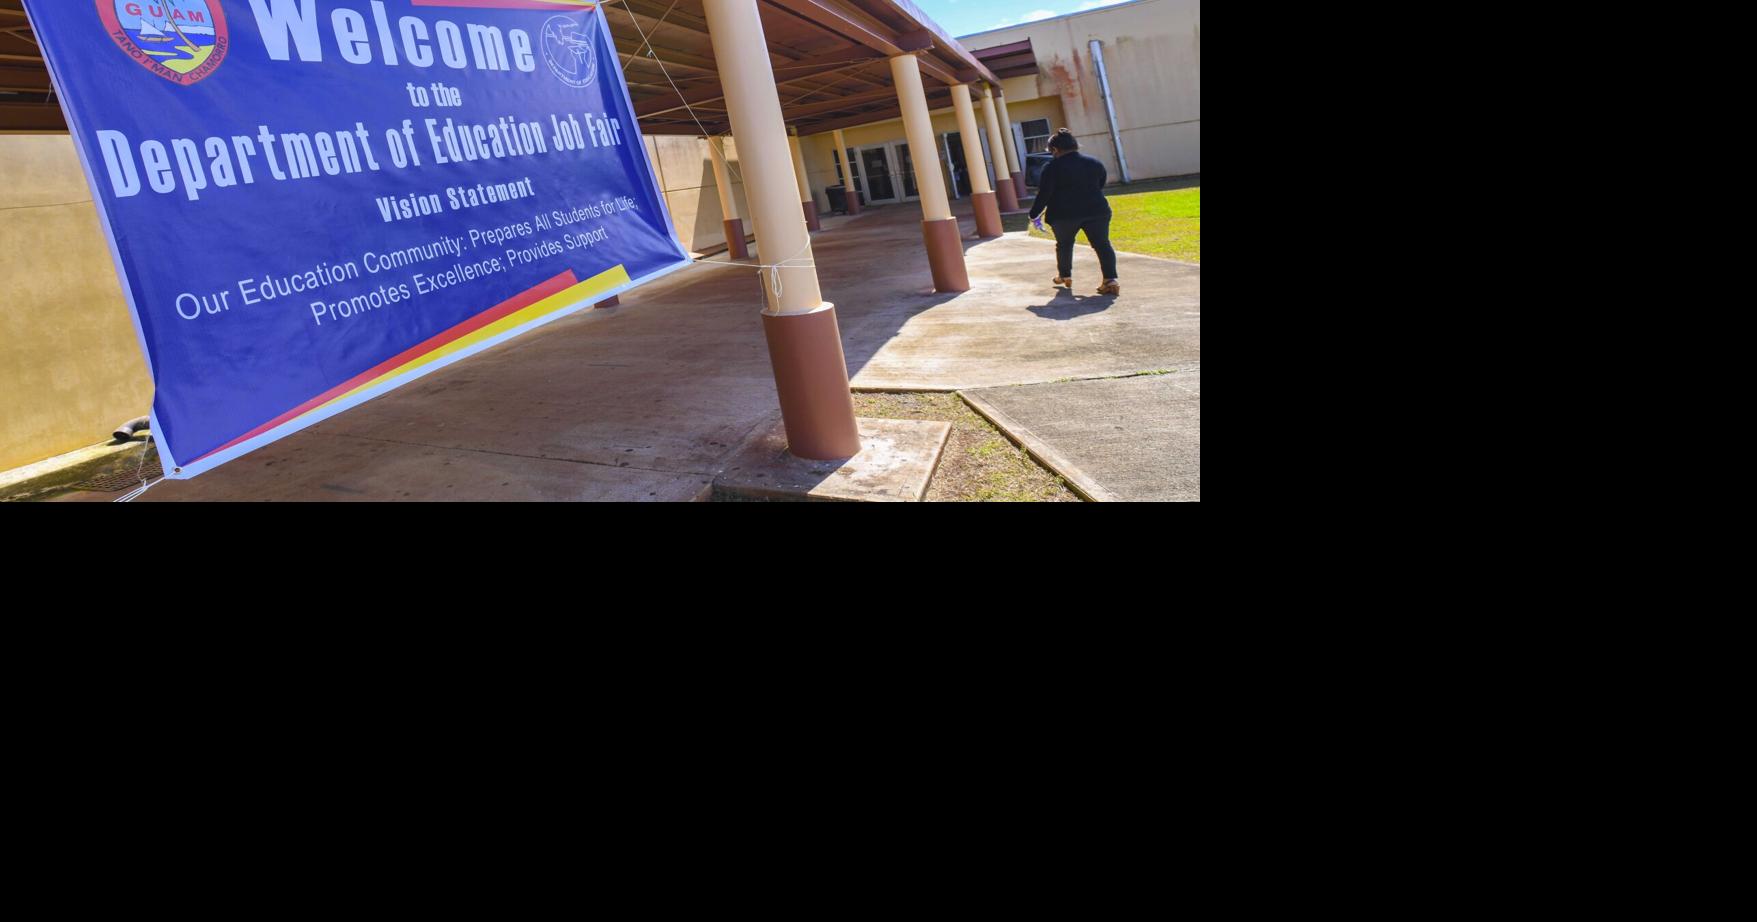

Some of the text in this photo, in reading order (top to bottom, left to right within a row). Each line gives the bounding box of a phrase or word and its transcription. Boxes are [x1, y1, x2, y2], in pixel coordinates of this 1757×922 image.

[125, 3, 205, 23] GUAM
[248, 0, 536, 72] Welcome
[189, 36, 227, 81] CHAMORRO
[406, 82, 463, 108] to the
[95, 112, 622, 201] Department of Education Job Fair
[375, 175, 536, 224] Vision Statement
[174, 195, 638, 321] Our Education Community: Prepares All Students for Life;
[311, 226, 609, 325] Promotes Excellence; Provides Support
